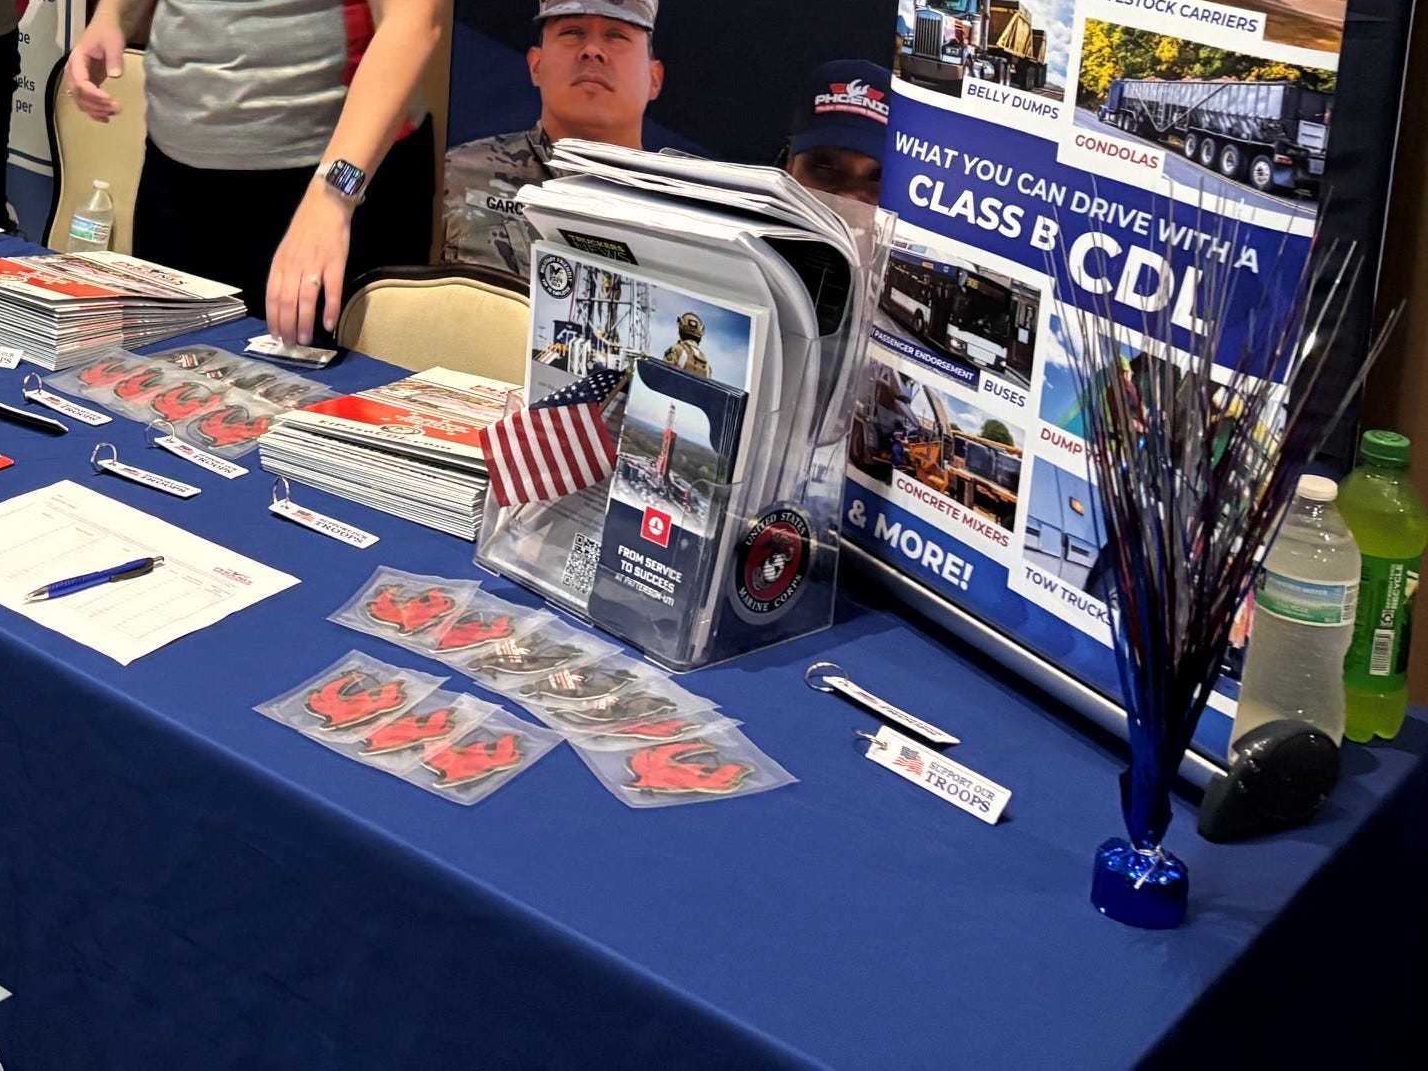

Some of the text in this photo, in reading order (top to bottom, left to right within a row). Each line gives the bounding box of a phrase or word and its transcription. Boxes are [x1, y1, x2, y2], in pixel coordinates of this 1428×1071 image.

[1180, 5, 1259, 33] CARRIERS
[15, 99, 32, 114] per
[968, 83, 1059, 120] BELLY DUMPS
[1075, 134, 1160, 170] GONDOLAS
[486, 196, 525, 216] GARC
[895, 131, 1260, 273] WHAT YOU CAN DRIVE WITH A
[908, 174, 1215, 338] CLASS B CDL
[874, 331, 975, 381] PASSENGER ENDORSEMENT
[984, 379, 1027, 408] BUSES
[1040, 428, 1083, 455] DUMP
[745, 512, 806, 546] UNITED STATES
[896, 477, 1010, 549] CONCRETE MIXERS
[315, 521, 363, 543] TROOPS
[847, 498, 974, 591] & MORE!
[618, 545, 682, 584] FROM SERVICE
[620, 560, 675, 594] TO SUCCESS
[1026, 566, 1059, 593] TOW
[739, 586, 769, 612] MARINE
[1390, 564, 1404, 610] RECYCLE
[925, 771, 991, 814] TROOPS
[929, 761, 996, 801] SUPPORT OUR
